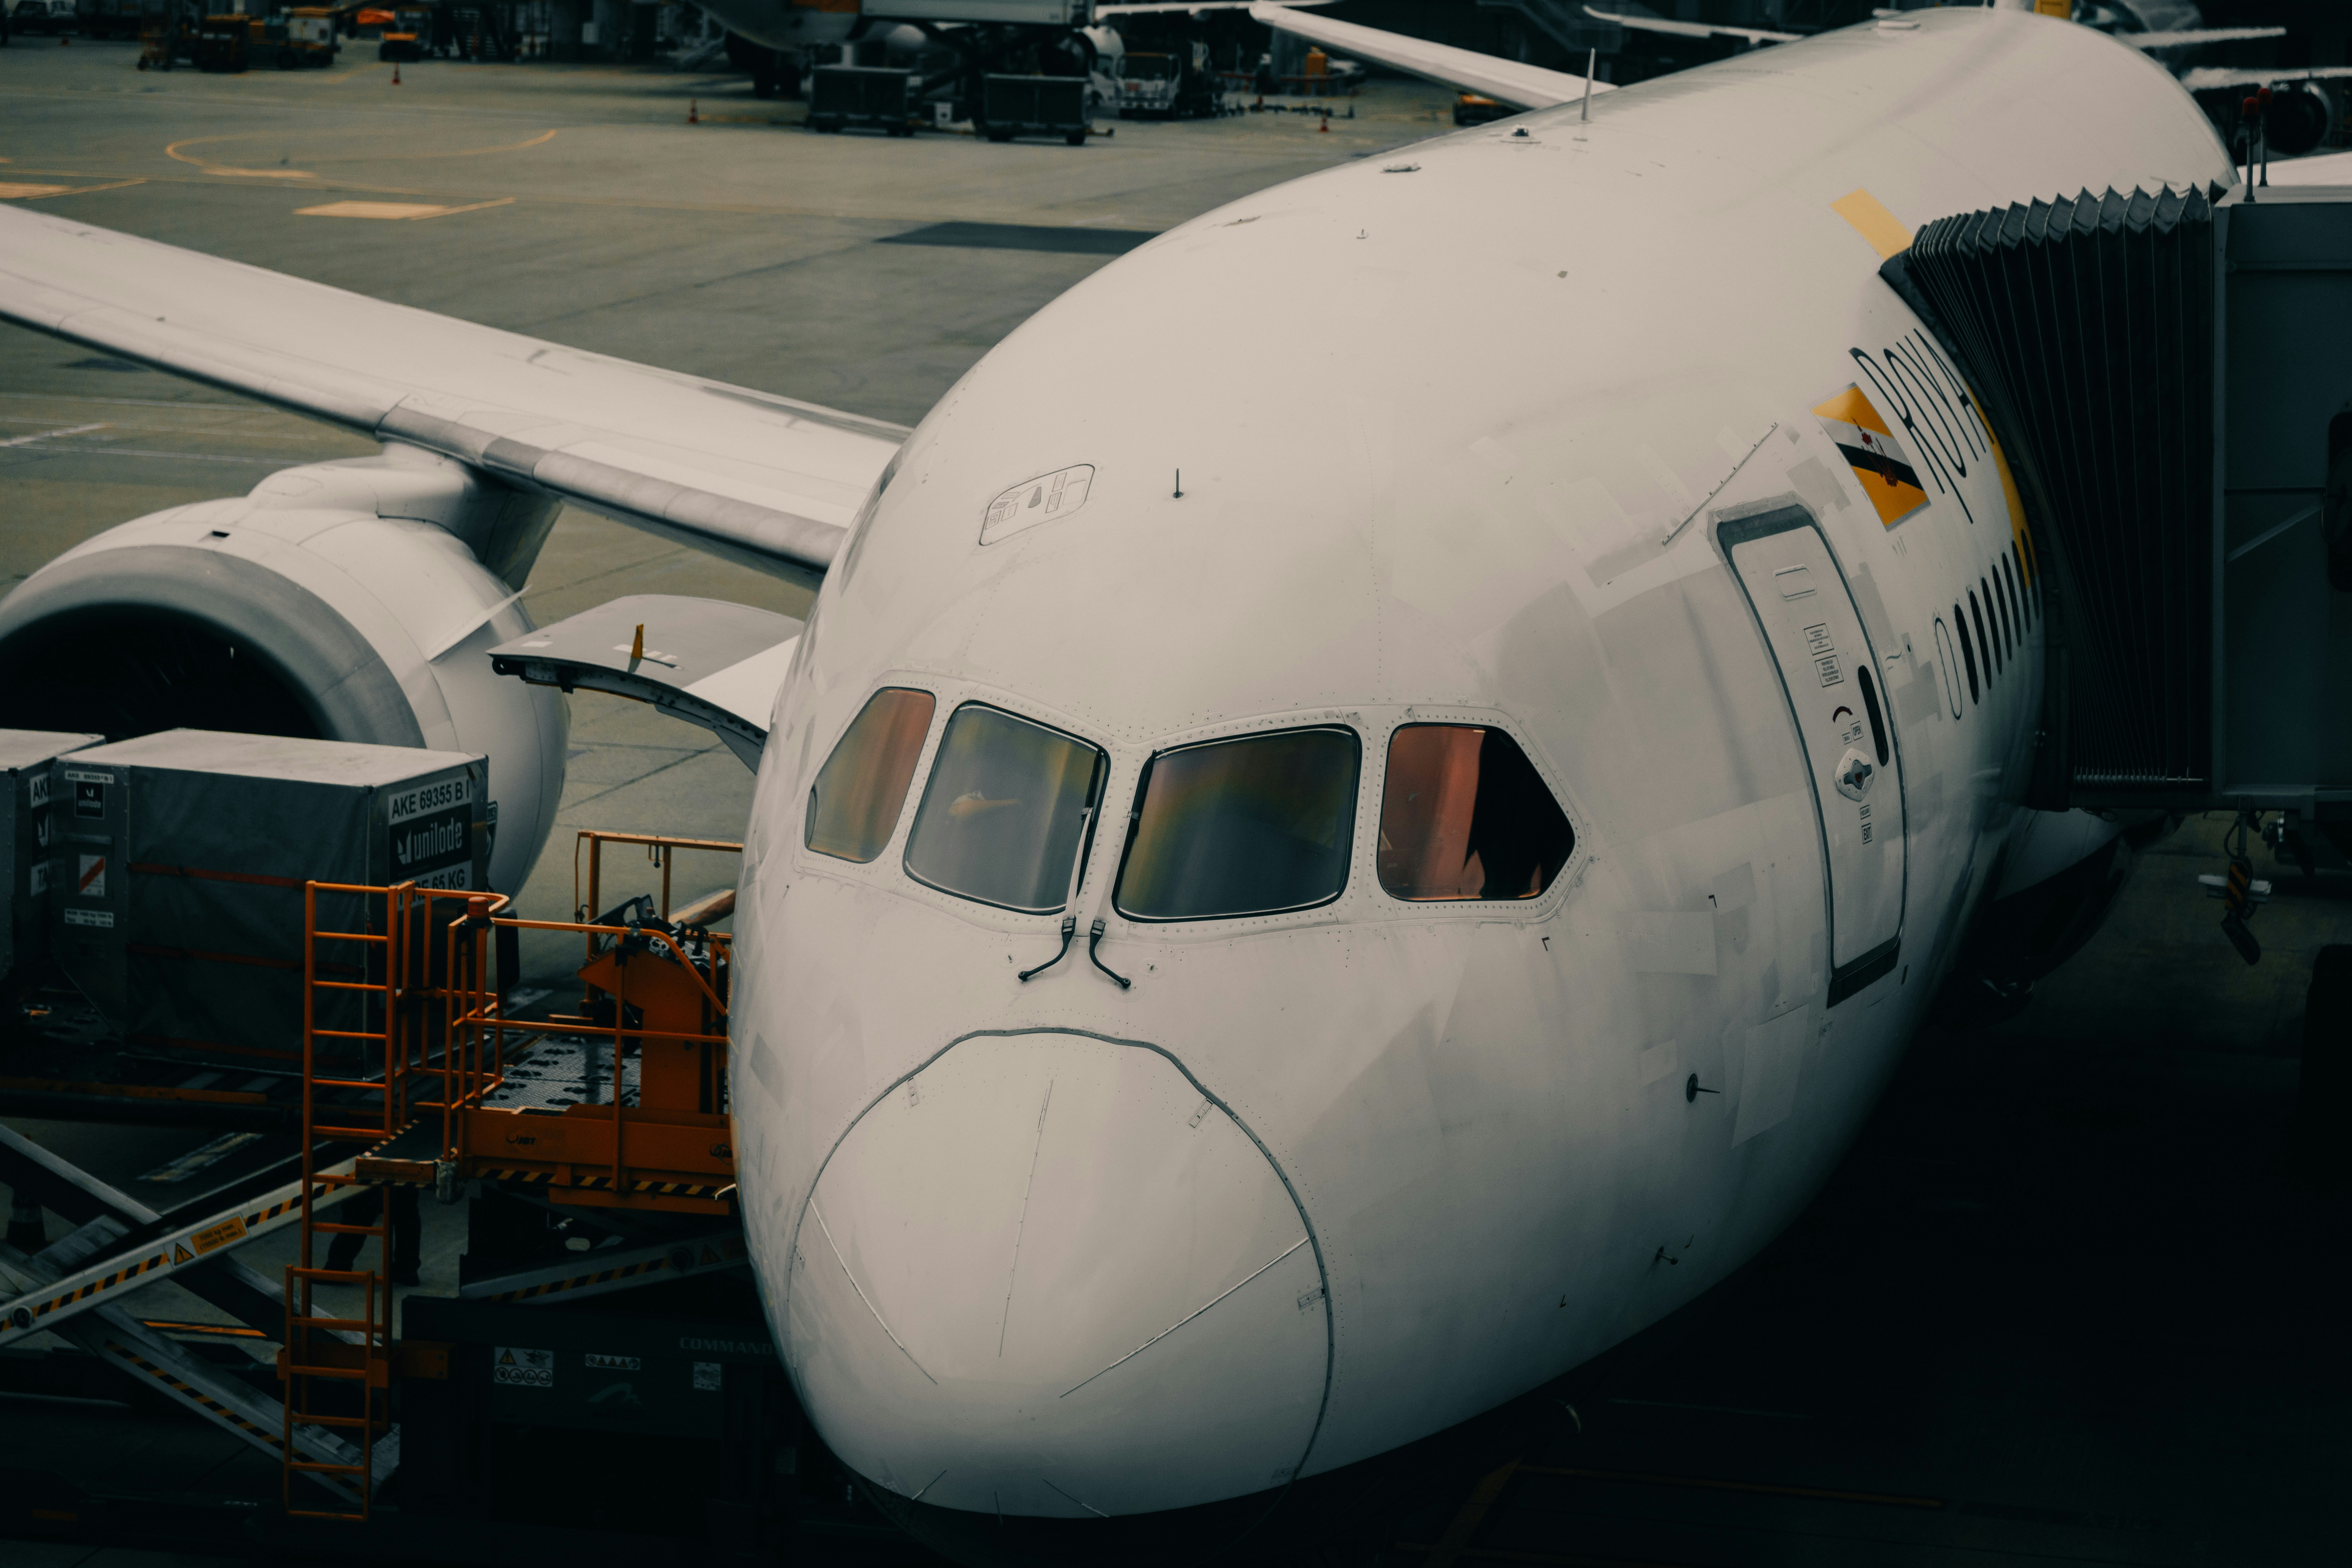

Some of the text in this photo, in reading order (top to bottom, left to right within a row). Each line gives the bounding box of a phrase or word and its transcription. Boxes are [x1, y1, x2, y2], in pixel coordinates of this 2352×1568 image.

[1853, 725, 1861, 736] OPEN
[392, 794, 416, 819] AKE
[420, 784, 452, 810] 69355
[455, 782, 463, 801] B
[414, 817, 463, 861] unilode
[1863, 826, 1871, 841] EXIT
[432, 874, 445, 889] 65
[448, 868, 465, 890] KG
